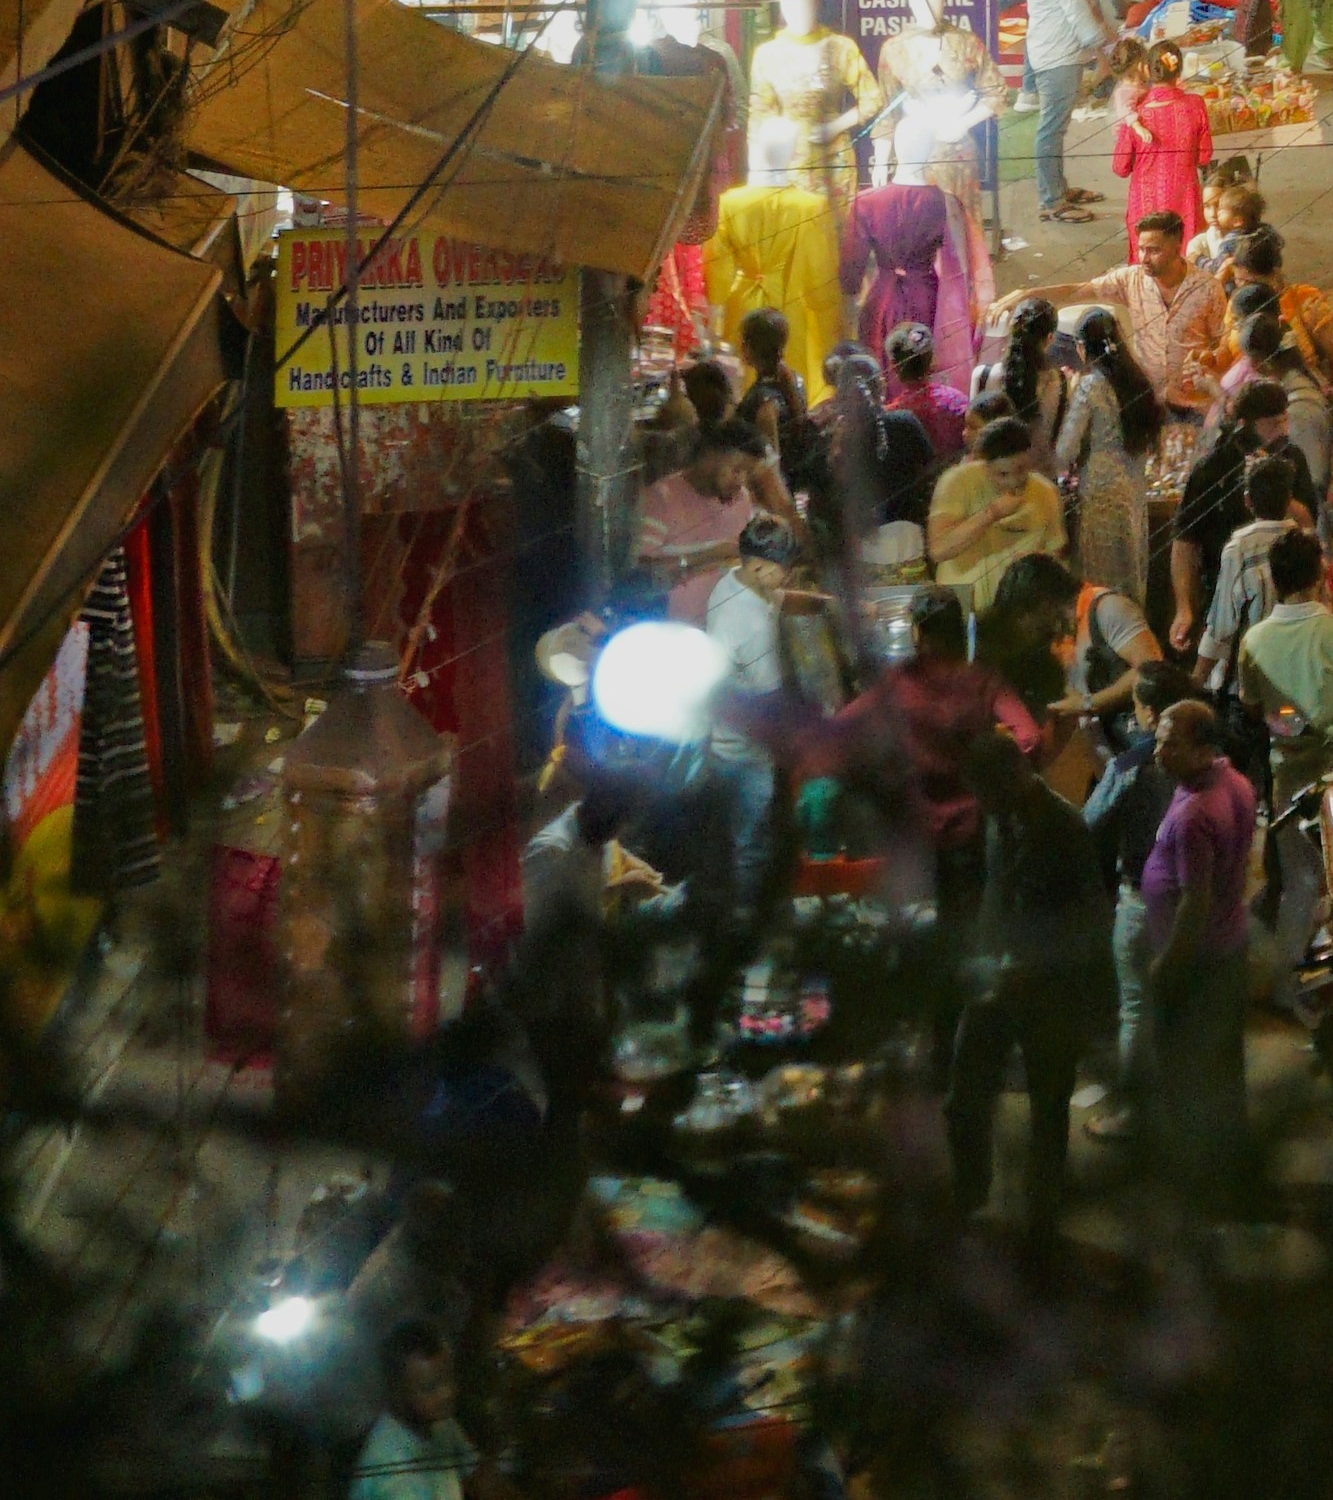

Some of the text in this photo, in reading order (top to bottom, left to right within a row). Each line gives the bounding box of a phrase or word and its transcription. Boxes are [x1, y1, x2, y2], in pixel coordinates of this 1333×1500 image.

[860, 15, 972, 37] PASHA
[290, 237, 424, 292] PRIYANKA
[295, 299, 425, 328] Manufacturers
[433, 295, 467, 321] And
[364, 326, 491, 356] Of All Kind Of
[289, 363, 392, 392] Handicafts
[401, 366, 414, 387] &
[423, 362, 477, 387] Indian
